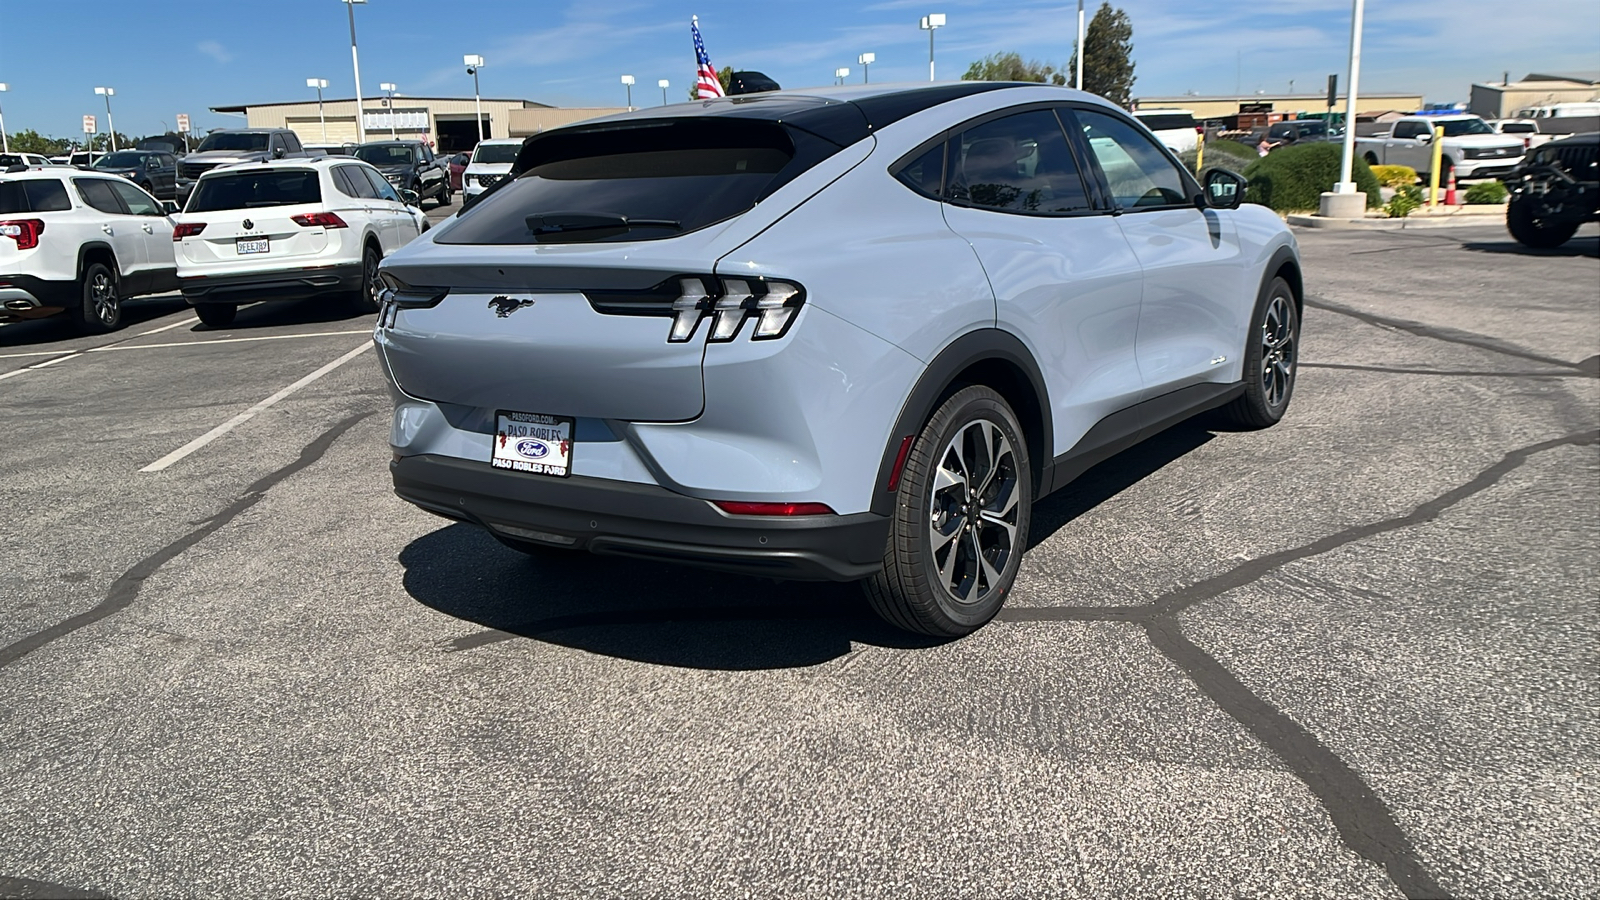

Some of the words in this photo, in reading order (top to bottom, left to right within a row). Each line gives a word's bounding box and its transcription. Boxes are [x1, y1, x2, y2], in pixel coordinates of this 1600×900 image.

[512, 412, 554, 424] PASOFORD.COM
[508, 424, 527, 439] PASO
[529, 427, 562, 443] ROBLES
[520, 441, 544, 456] Ford
[492, 458, 512, 469] PASO
[513, 461, 543, 473] ROBLES
